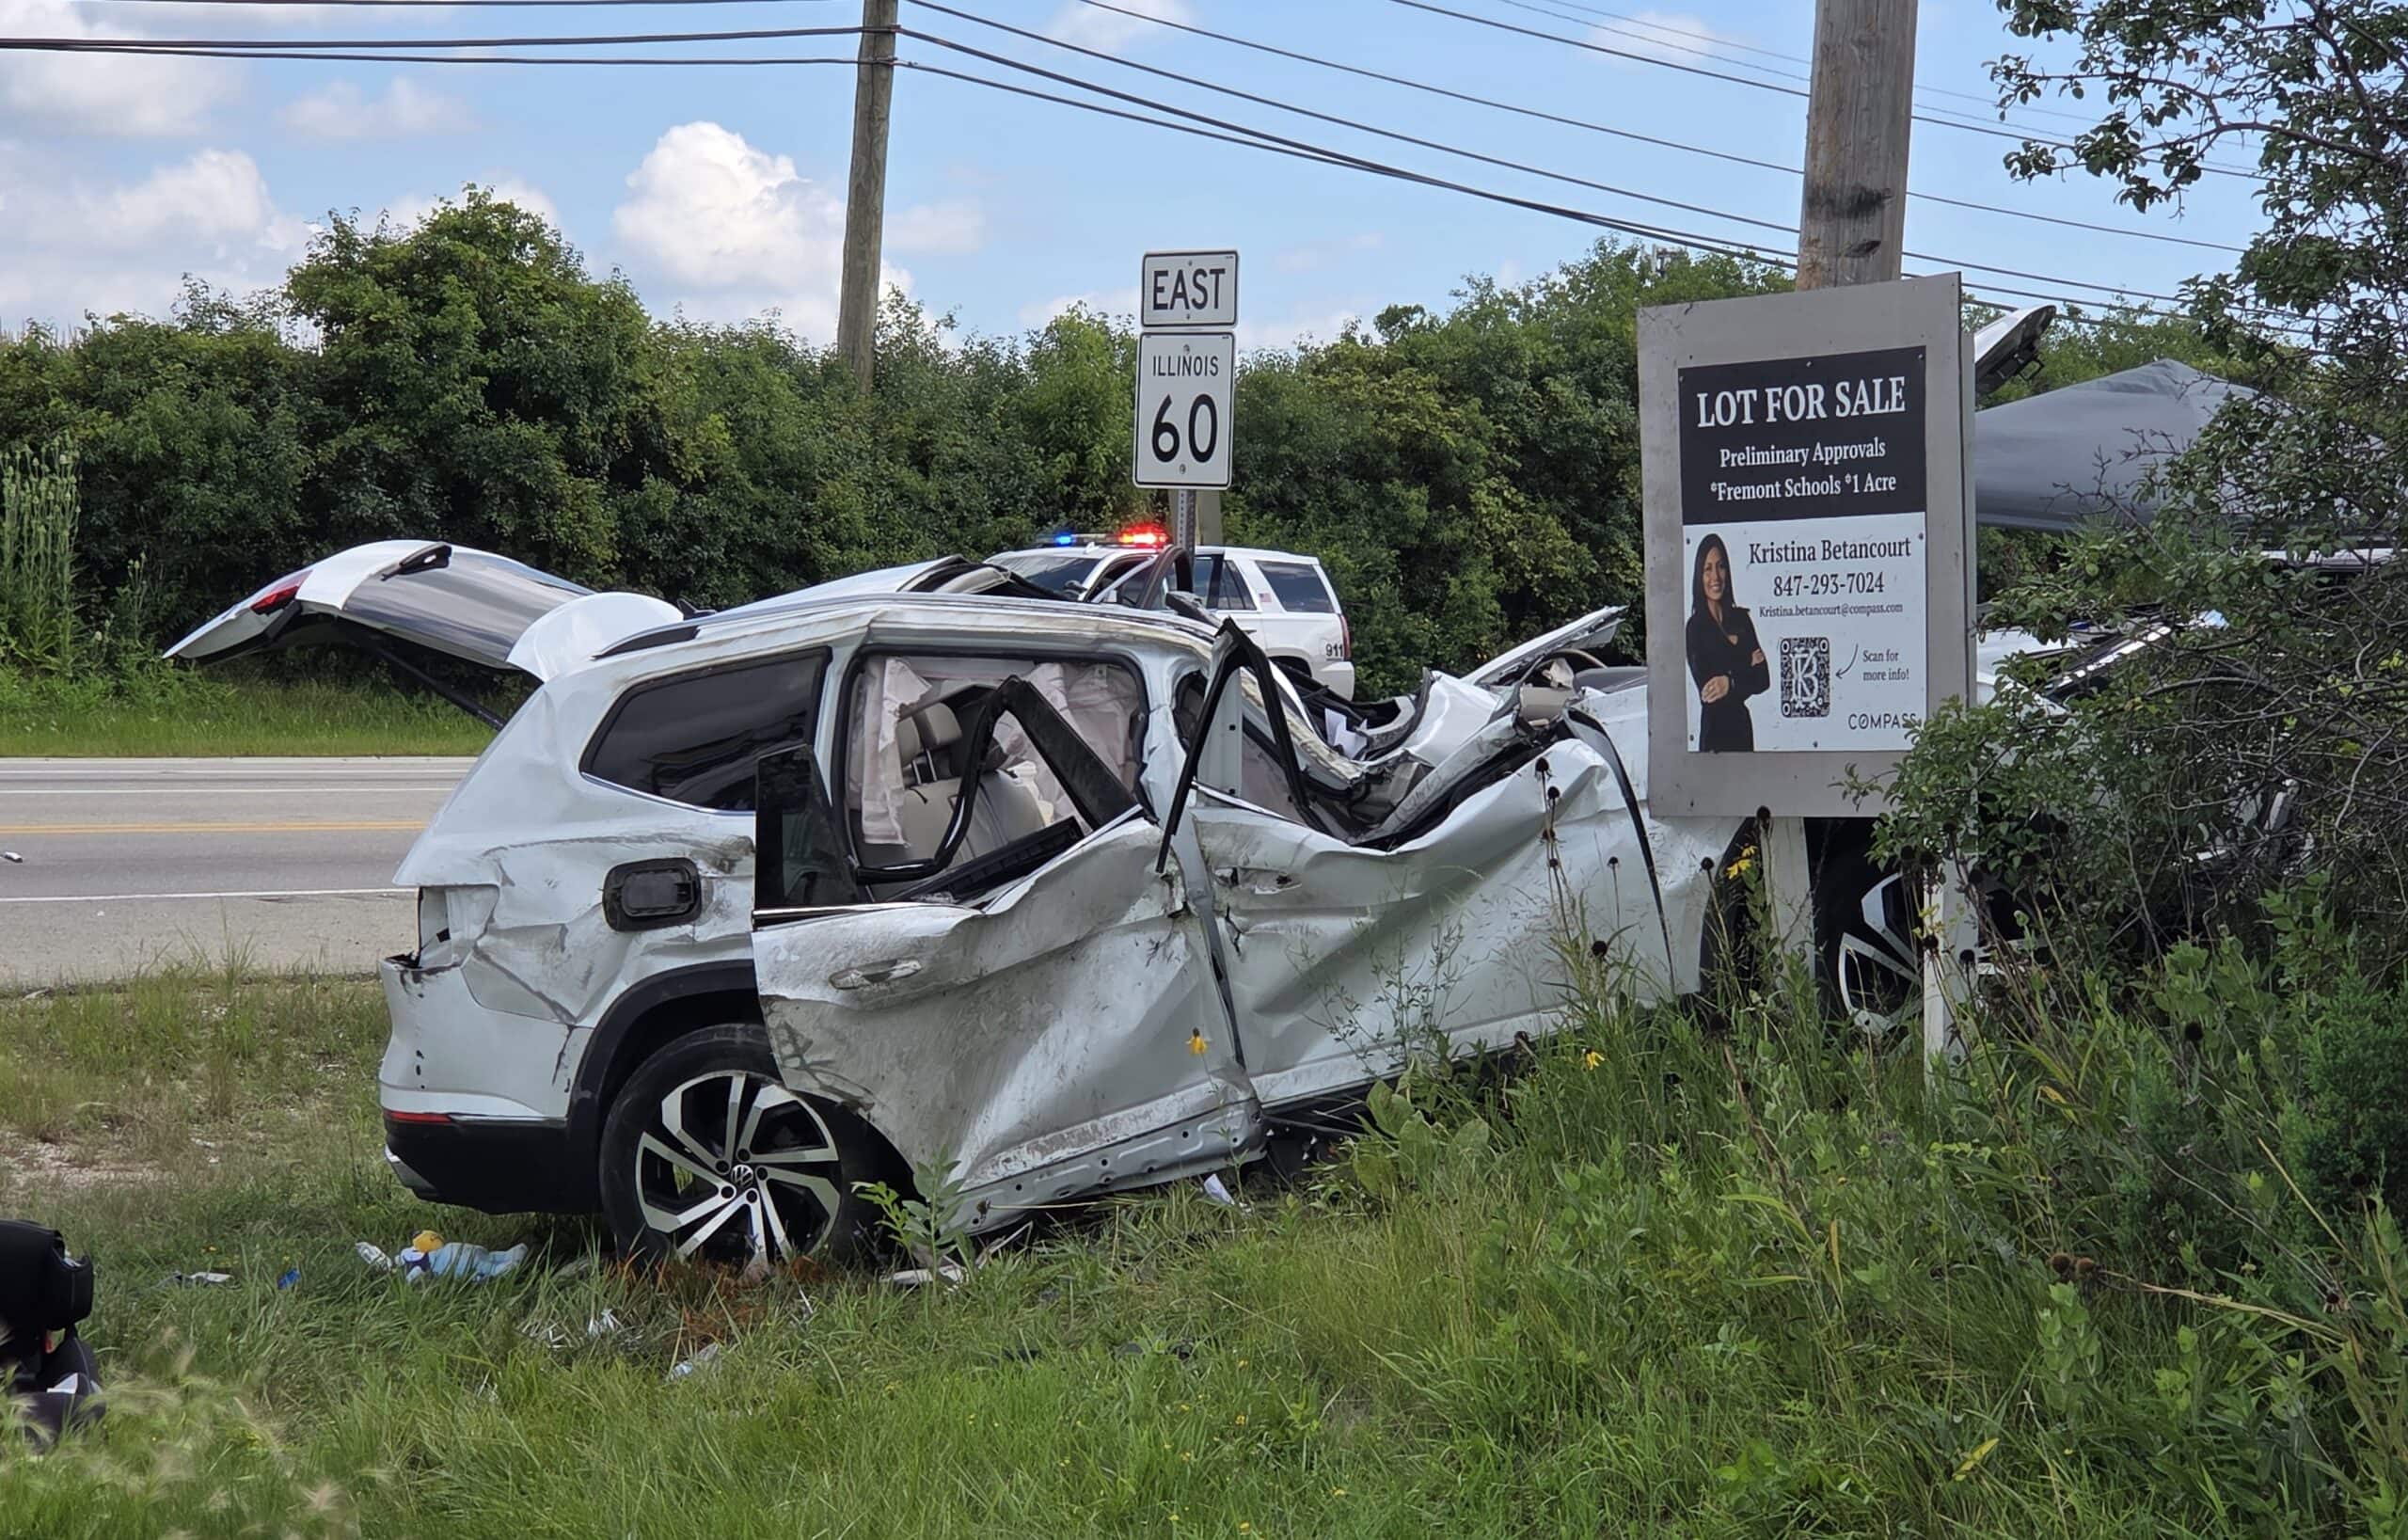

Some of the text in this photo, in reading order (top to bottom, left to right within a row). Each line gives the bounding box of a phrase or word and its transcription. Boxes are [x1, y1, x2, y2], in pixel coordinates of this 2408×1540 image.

[1153, 268, 1226, 310] EAST
[1153, 356, 1219, 376] ILLINOIS
[1697, 376, 1906, 427] LOT FOR SALE
[1151, 394, 1218, 463] 60
[1719, 437, 1886, 468] Preliminary Approvals
[1784, 474, 1842, 498] Schools
[1863, 472, 1897, 492] Acre
[1750, 537, 1911, 564] Kristina Betancourt
[1773, 571, 1885, 596] 847-293-7024
[1759, 603, 1904, 618] Kristina.betancourt@compass.com
[1325, 643, 1343, 657] 911
[1862, 648, 1899, 662] Scan for
[1862, 668, 1909, 681] more info!
